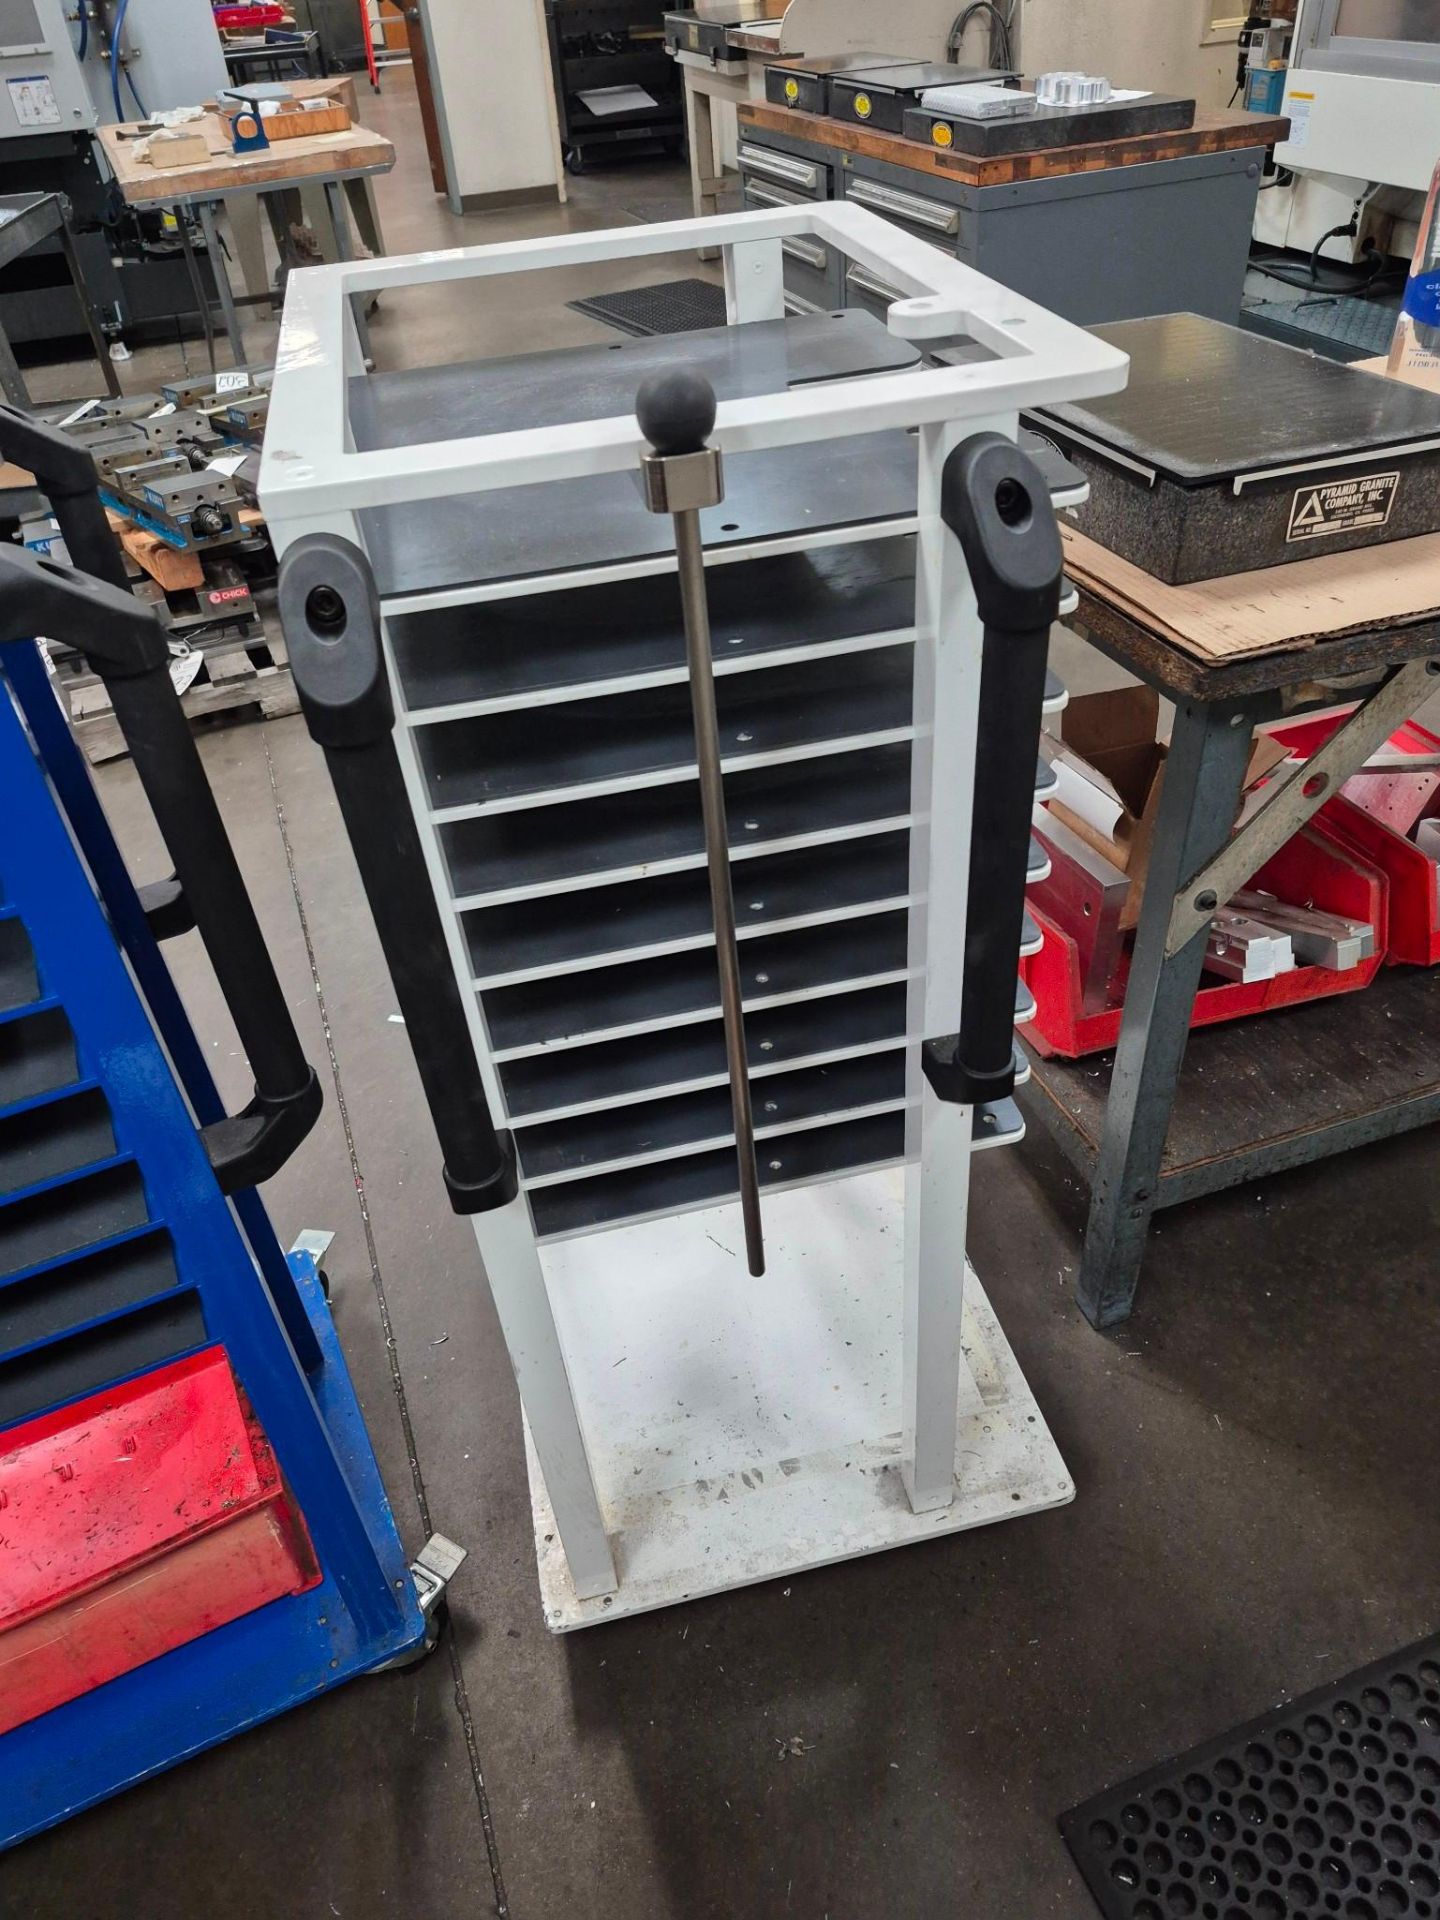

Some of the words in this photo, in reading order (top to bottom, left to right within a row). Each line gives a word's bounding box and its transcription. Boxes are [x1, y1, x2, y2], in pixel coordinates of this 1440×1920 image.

[1320, 484, 1357, 500] PYRAMID
[1360, 477, 1395, 491] GRANITE
[1325, 493, 1364, 509] COMPANY,
[221, 588, 247, 599] CHICK
